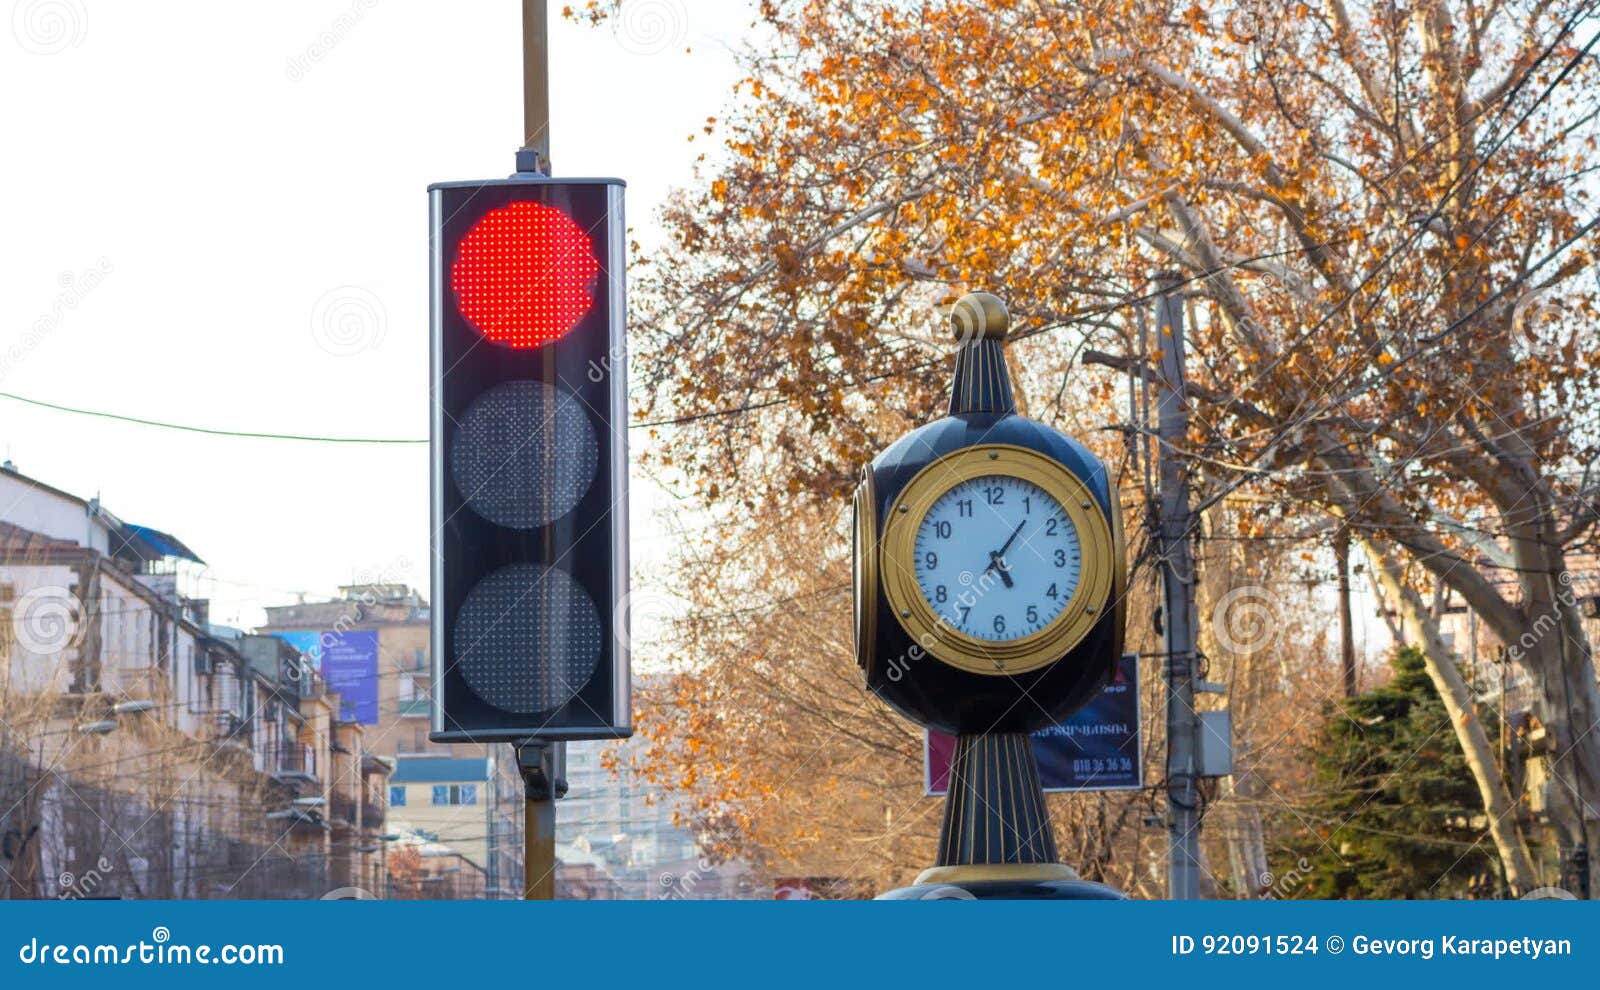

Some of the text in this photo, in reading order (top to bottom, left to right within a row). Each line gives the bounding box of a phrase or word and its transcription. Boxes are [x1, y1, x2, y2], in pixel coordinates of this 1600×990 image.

[984, 487, 1004, 505] 12
[956, 500, 973, 517] 11
[1022, 497, 1030, 514] 1
[933, 520, 951, 539] 10
[1046, 519, 1057, 536] 2
[926, 552, 938, 570] 9
[1054, 549, 1066, 568] 3
[936, 585, 947, 603] 8
[1046, 583, 1058, 600] 4
[959, 607, 971, 624] 7
[1026, 606, 1038, 623] 5
[994, 616, 1006, 634] 6
